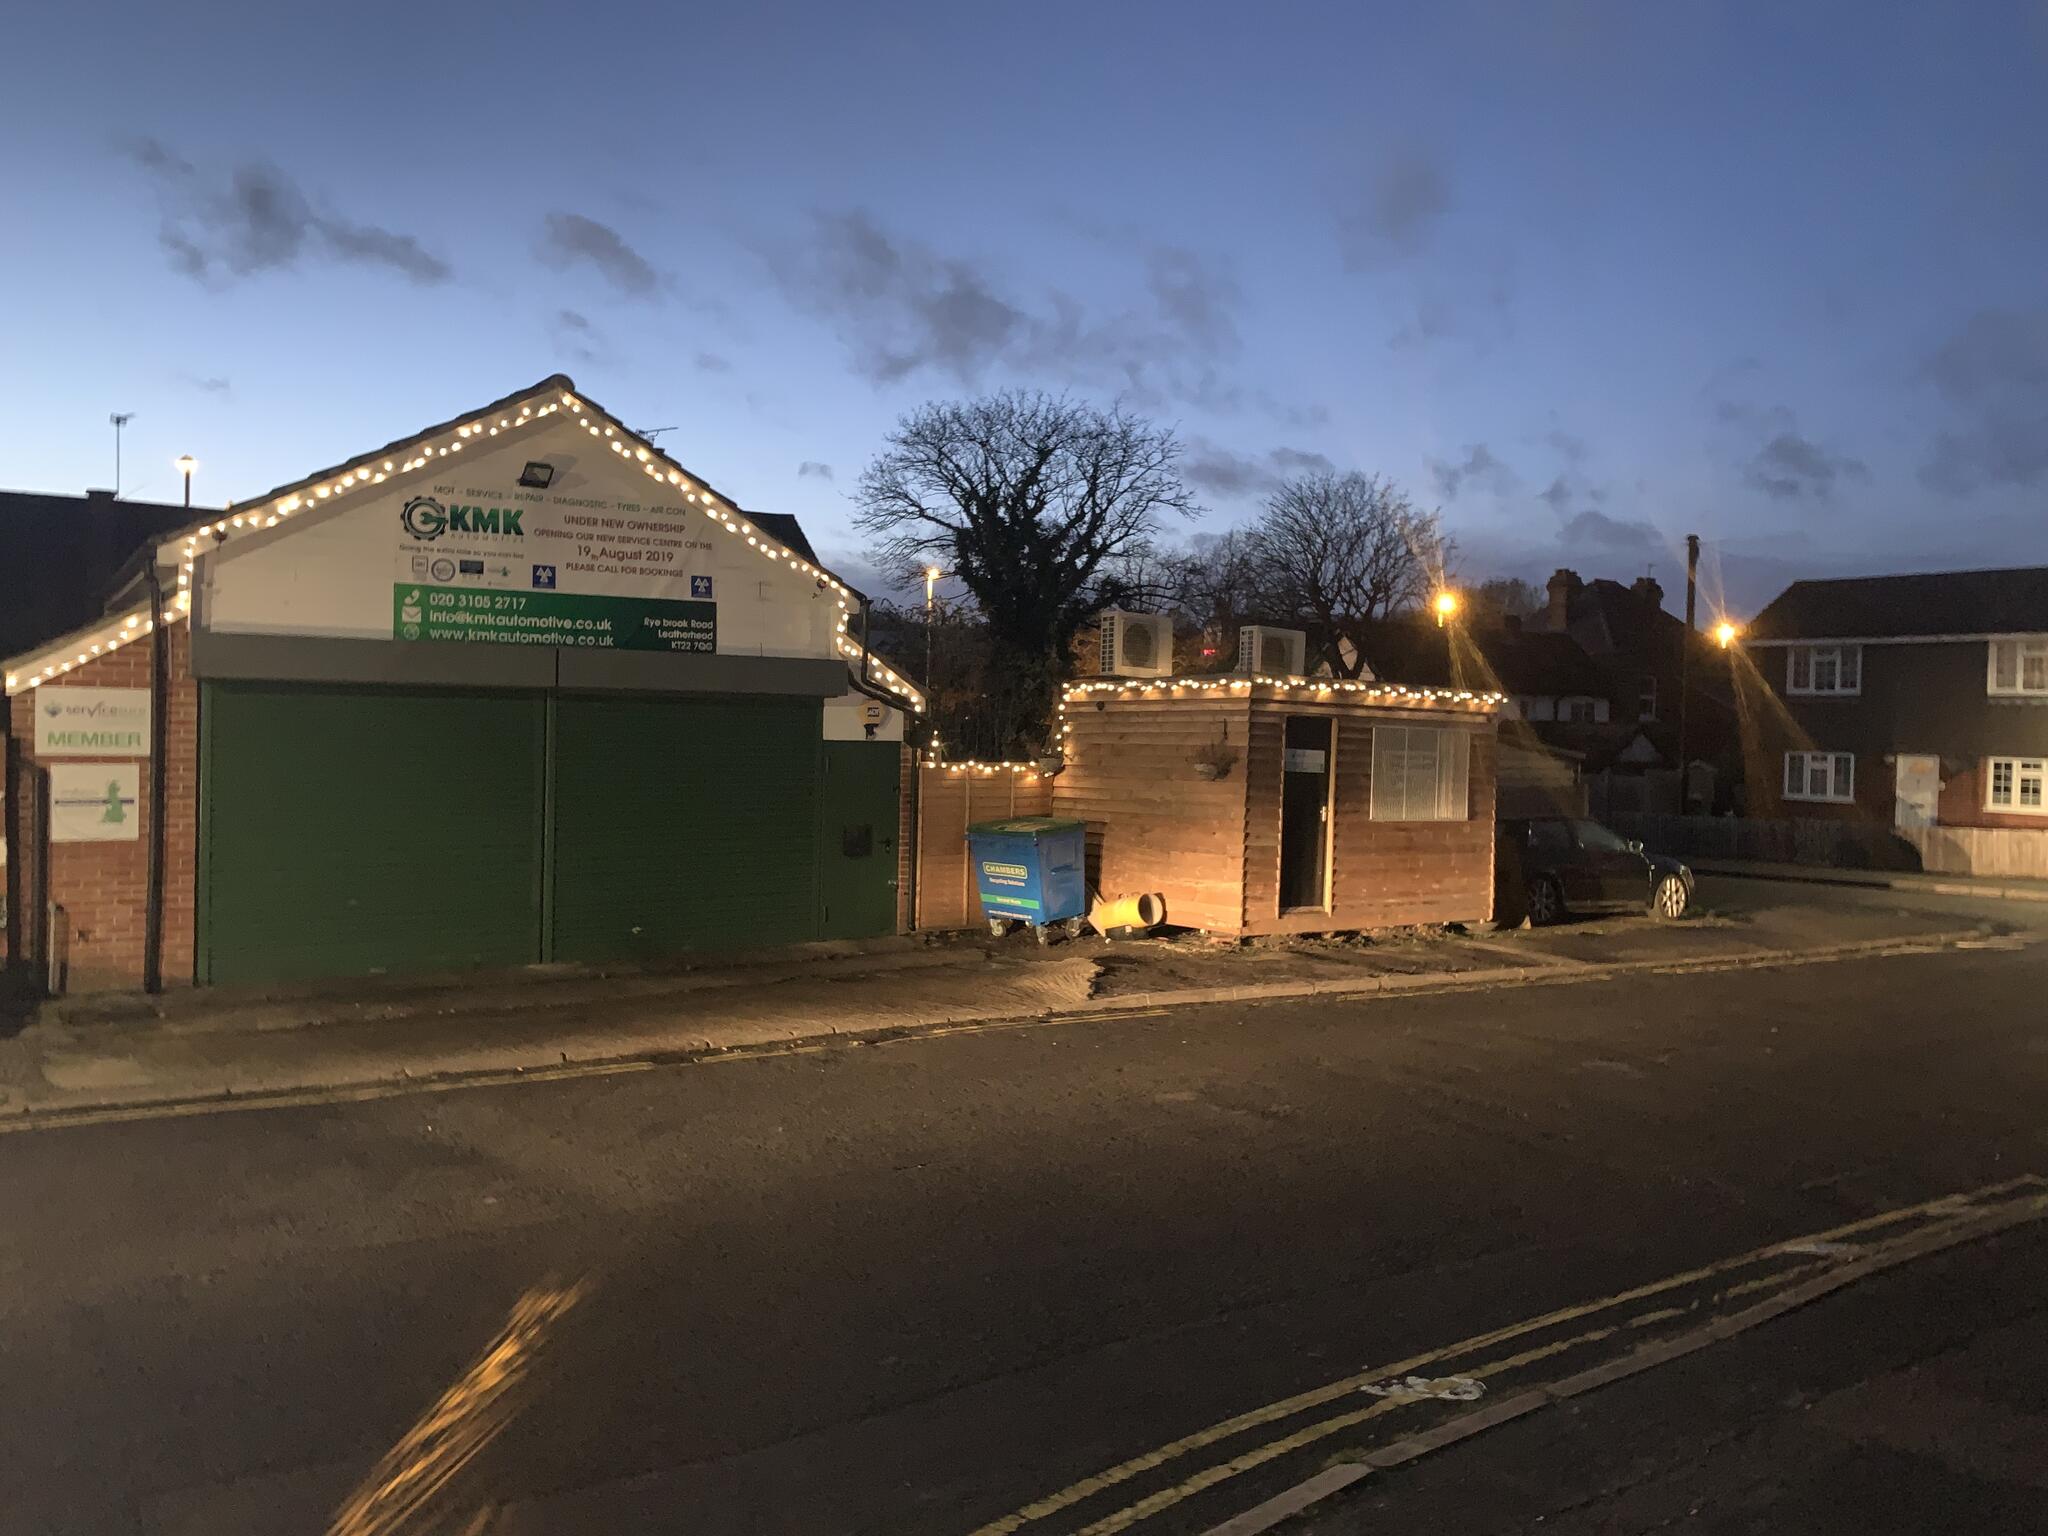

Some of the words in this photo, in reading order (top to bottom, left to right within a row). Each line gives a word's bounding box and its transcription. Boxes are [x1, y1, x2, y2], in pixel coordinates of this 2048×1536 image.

[466, 488, 503, 499] SERVICE
[514, 491, 544, 502] REPAIR
[553, 495, 607, 509] DIAGNOSTIC
[617, 502, 640, 512] TYRES
[650, 506, 664, 514] AIR
[666, 507, 686, 516] CON
[450, 504, 524, 536] KMK
[564, 515, 598, 527] UNDER
[601, 518, 624, 529] NEW
[627, 519, 685, 533] OWNERSHIP
[534, 528, 573, 539] OPENING
[576, 532, 594, 541] OUR
[596, 534, 615, 543] NEW
[617, 536, 650, 546] SERVICE
[653, 538, 682, 548] CENTRE
[684, 541, 697, 549] ON
[699, 542, 713, 550] THE
[600, 548, 642, 562] August
[646, 551, 674, 562] 2019
[566, 561, 595, 572] PLEASE
[597, 564, 618, 574] CALL
[621, 566, 637, 575] FOR
[639, 567, 683, 577] BOOKINGS
[429, 592, 455, 607] 020
[458, 594, 491, 609] 3105
[495, 596, 527, 611] 2717
[644, 617, 661, 628] Rye
[663, 618, 688, 628] brook
[691, 619, 713, 629] Road
[429, 627, 614, 647] www.kmkautomotive.co.uk
[658, 630, 713, 640] Leatherhead
[671, 641, 691, 650] KT22
[47, 731, 142, 747] MEMBER
[985, 864, 1025, 876] CHAMBERS
